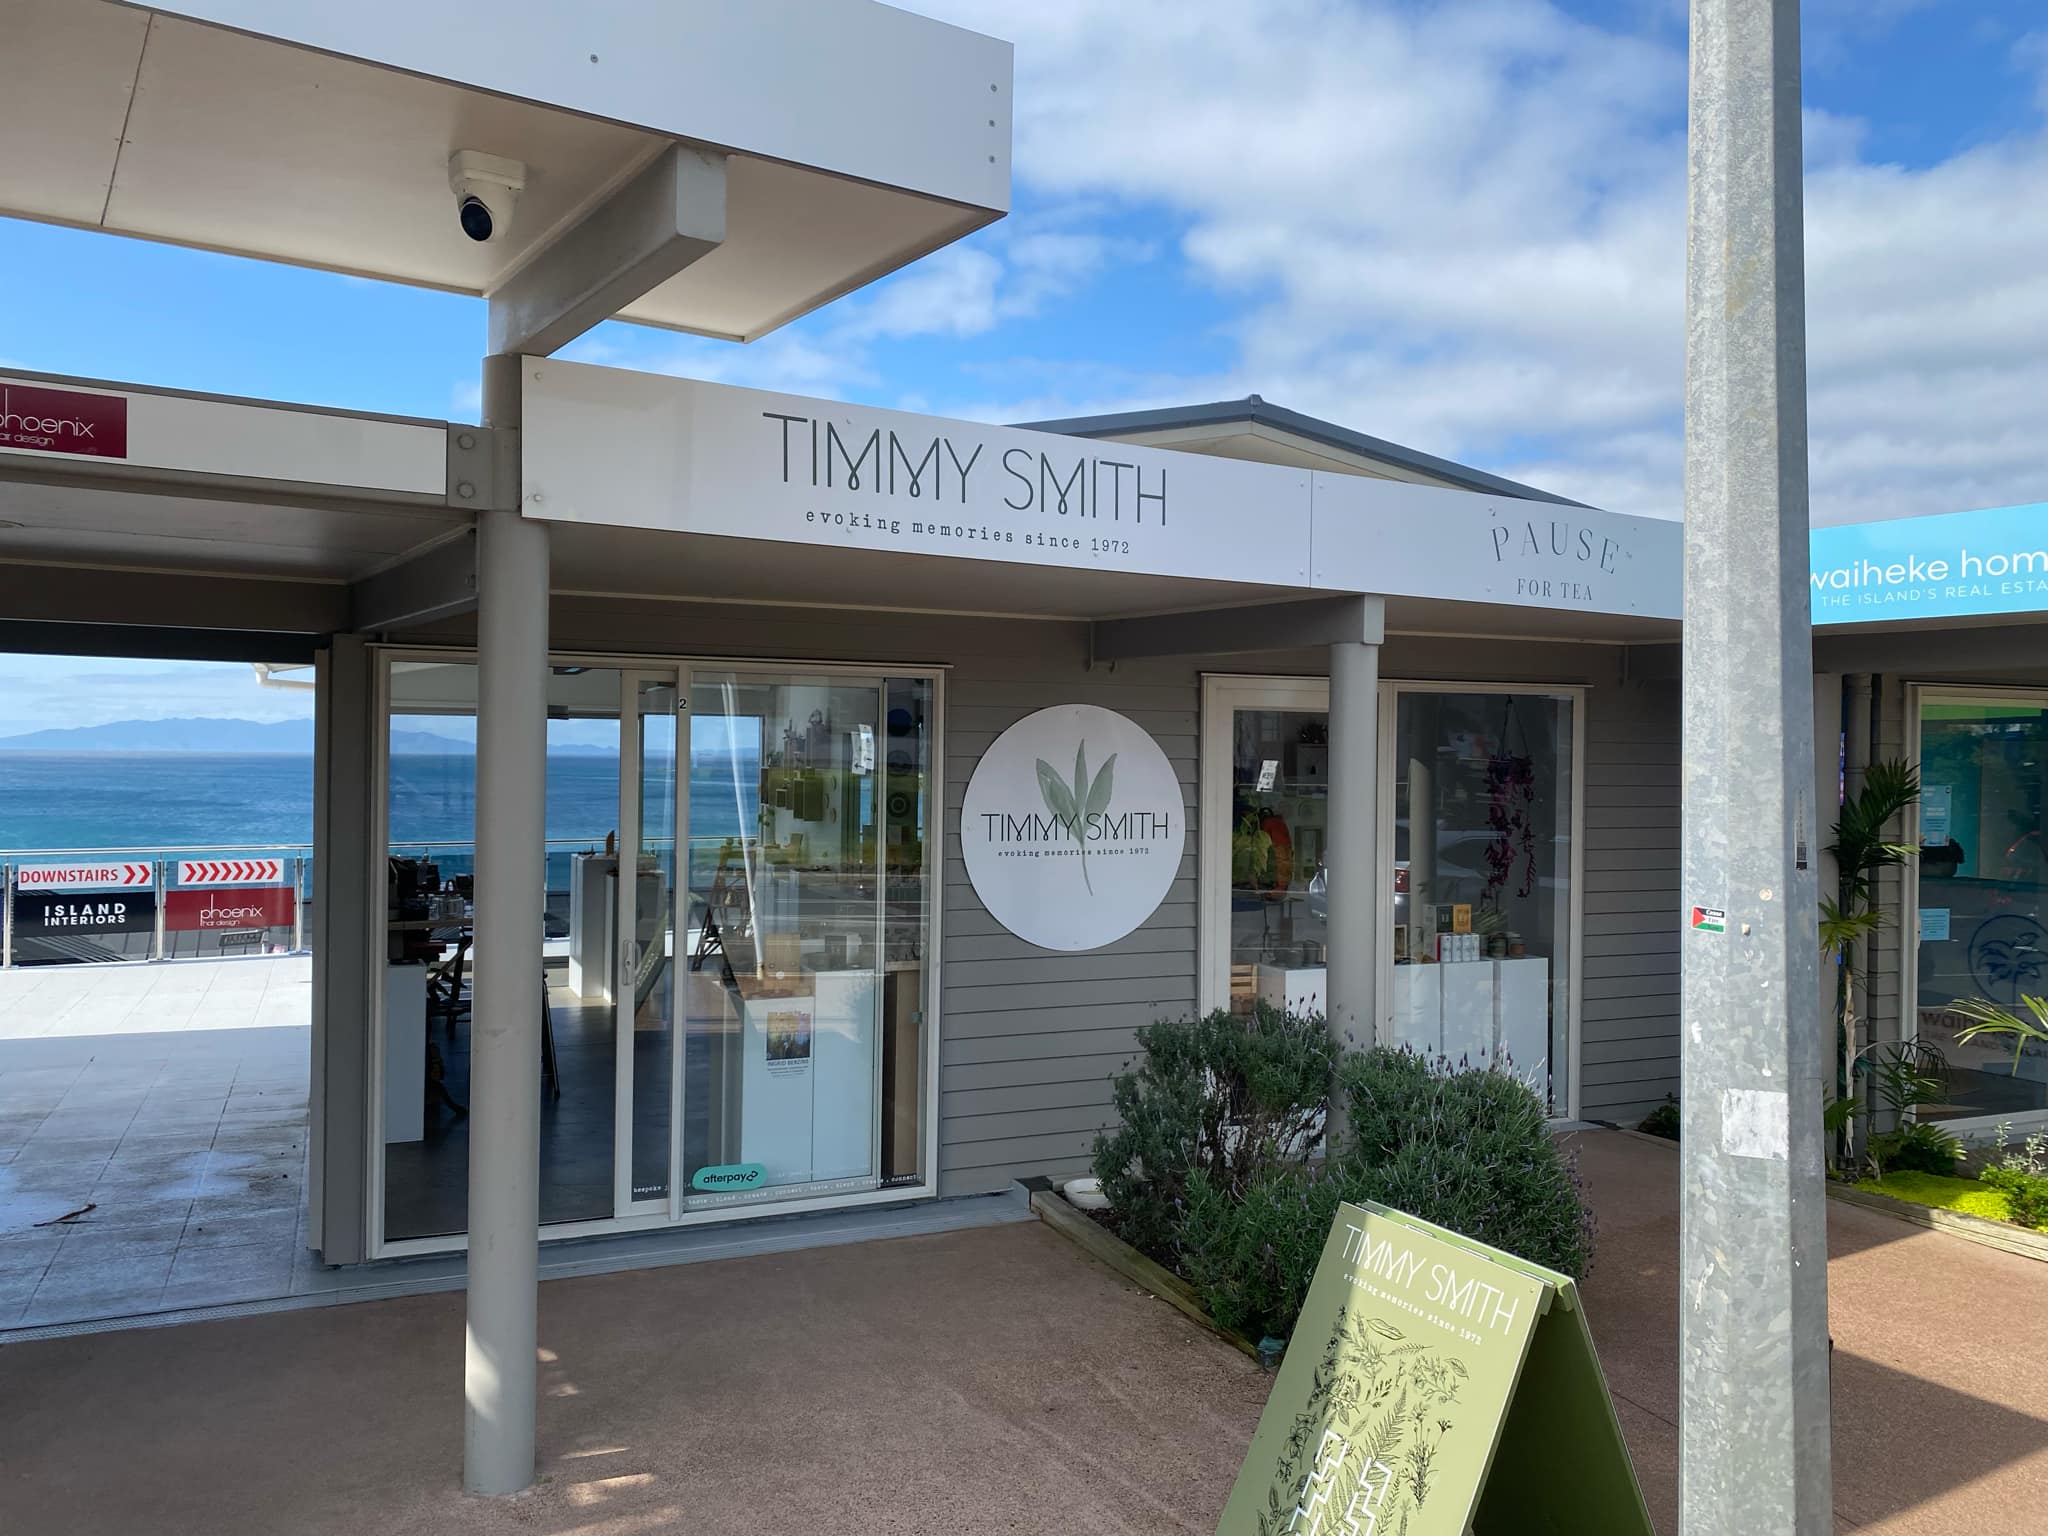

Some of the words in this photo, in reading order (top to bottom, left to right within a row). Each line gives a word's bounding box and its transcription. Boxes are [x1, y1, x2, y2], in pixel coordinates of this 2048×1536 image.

[762, 411, 984, 504] TIMMY
[1001, 447, 1167, 527] SMITH
[805, 510, 901, 534] evoking
[912, 521, 1014, 542] memories
[1025, 532, 1080, 549] since
[1091, 537, 1129, 554] 1972
[1491, 520, 1619, 575] PAUSE
[1516, 577, 1552, 598] FOR
[1560, 582, 1593, 601] TEA
[1821, 594, 1851, 608] THE
[1857, 587, 1938, 606] ISLAND'S
[1945, 583, 1993, 599] REAL
[679, 698, 687, 709] 2
[980, 812, 1078, 843] TIMMY
[1086, 811, 1169, 842] SMITH
[997, 849, 1040, 858] evoking
[1044, 848, 1092, 856] memories
[1096, 848, 1125, 856] since
[20, 868, 119, 884] DOWNSTAIRS
[44, 902, 127, 918] ISLAND
[44, 913, 127, 928] INTERIORS
[200, 893, 264, 927] phoenix
[703, 1173, 746, 1184] afterpay
[1341, 1223, 1427, 1289] TIMMY
[1425, 1263, 1520, 1336] SMITH
[1343, 1272, 1378, 1297] evoking
[1379, 1290, 1425, 1318] memories
[1427, 1313, 1456, 1333] since
[1459, 1327, 1483, 1346] 1972
